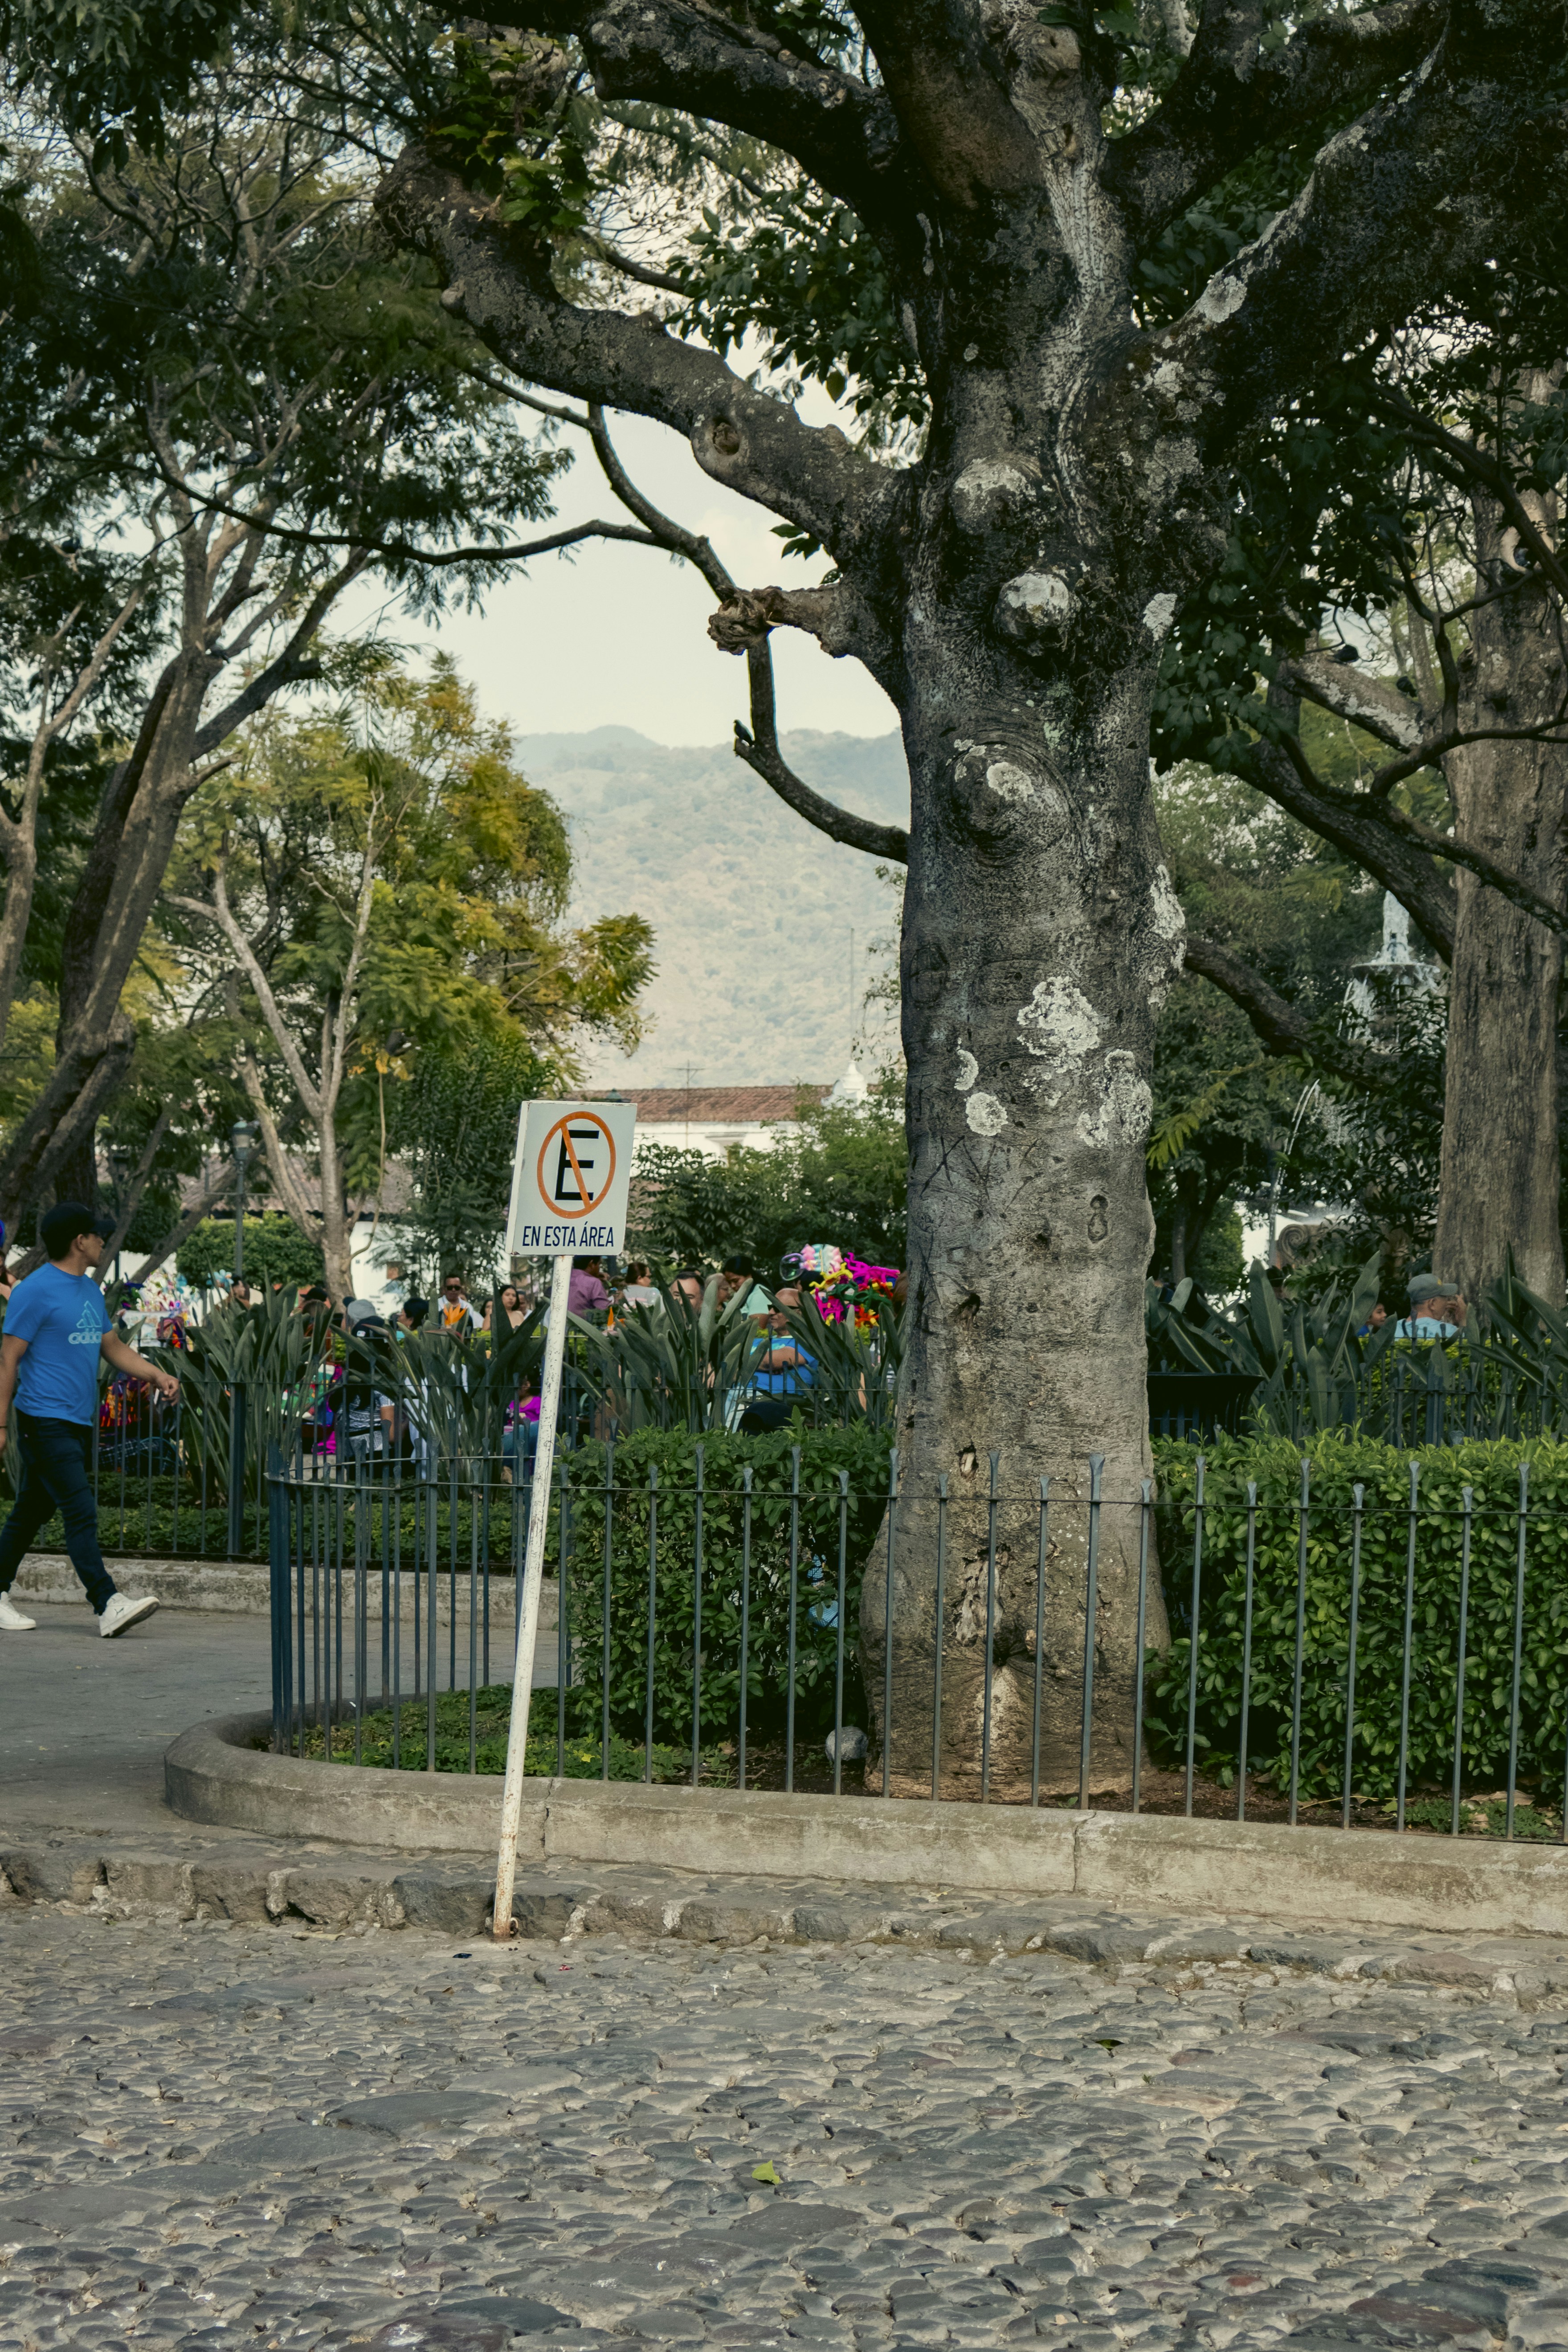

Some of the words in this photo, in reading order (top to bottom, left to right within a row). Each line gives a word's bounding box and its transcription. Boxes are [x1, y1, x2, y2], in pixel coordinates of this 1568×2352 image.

[555, 1130, 600, 1200] E
[522, 1226, 541, 1246] EN
[544, 1226, 576, 1247] ESTA
[579, 1221, 614, 1247] ÁREA
